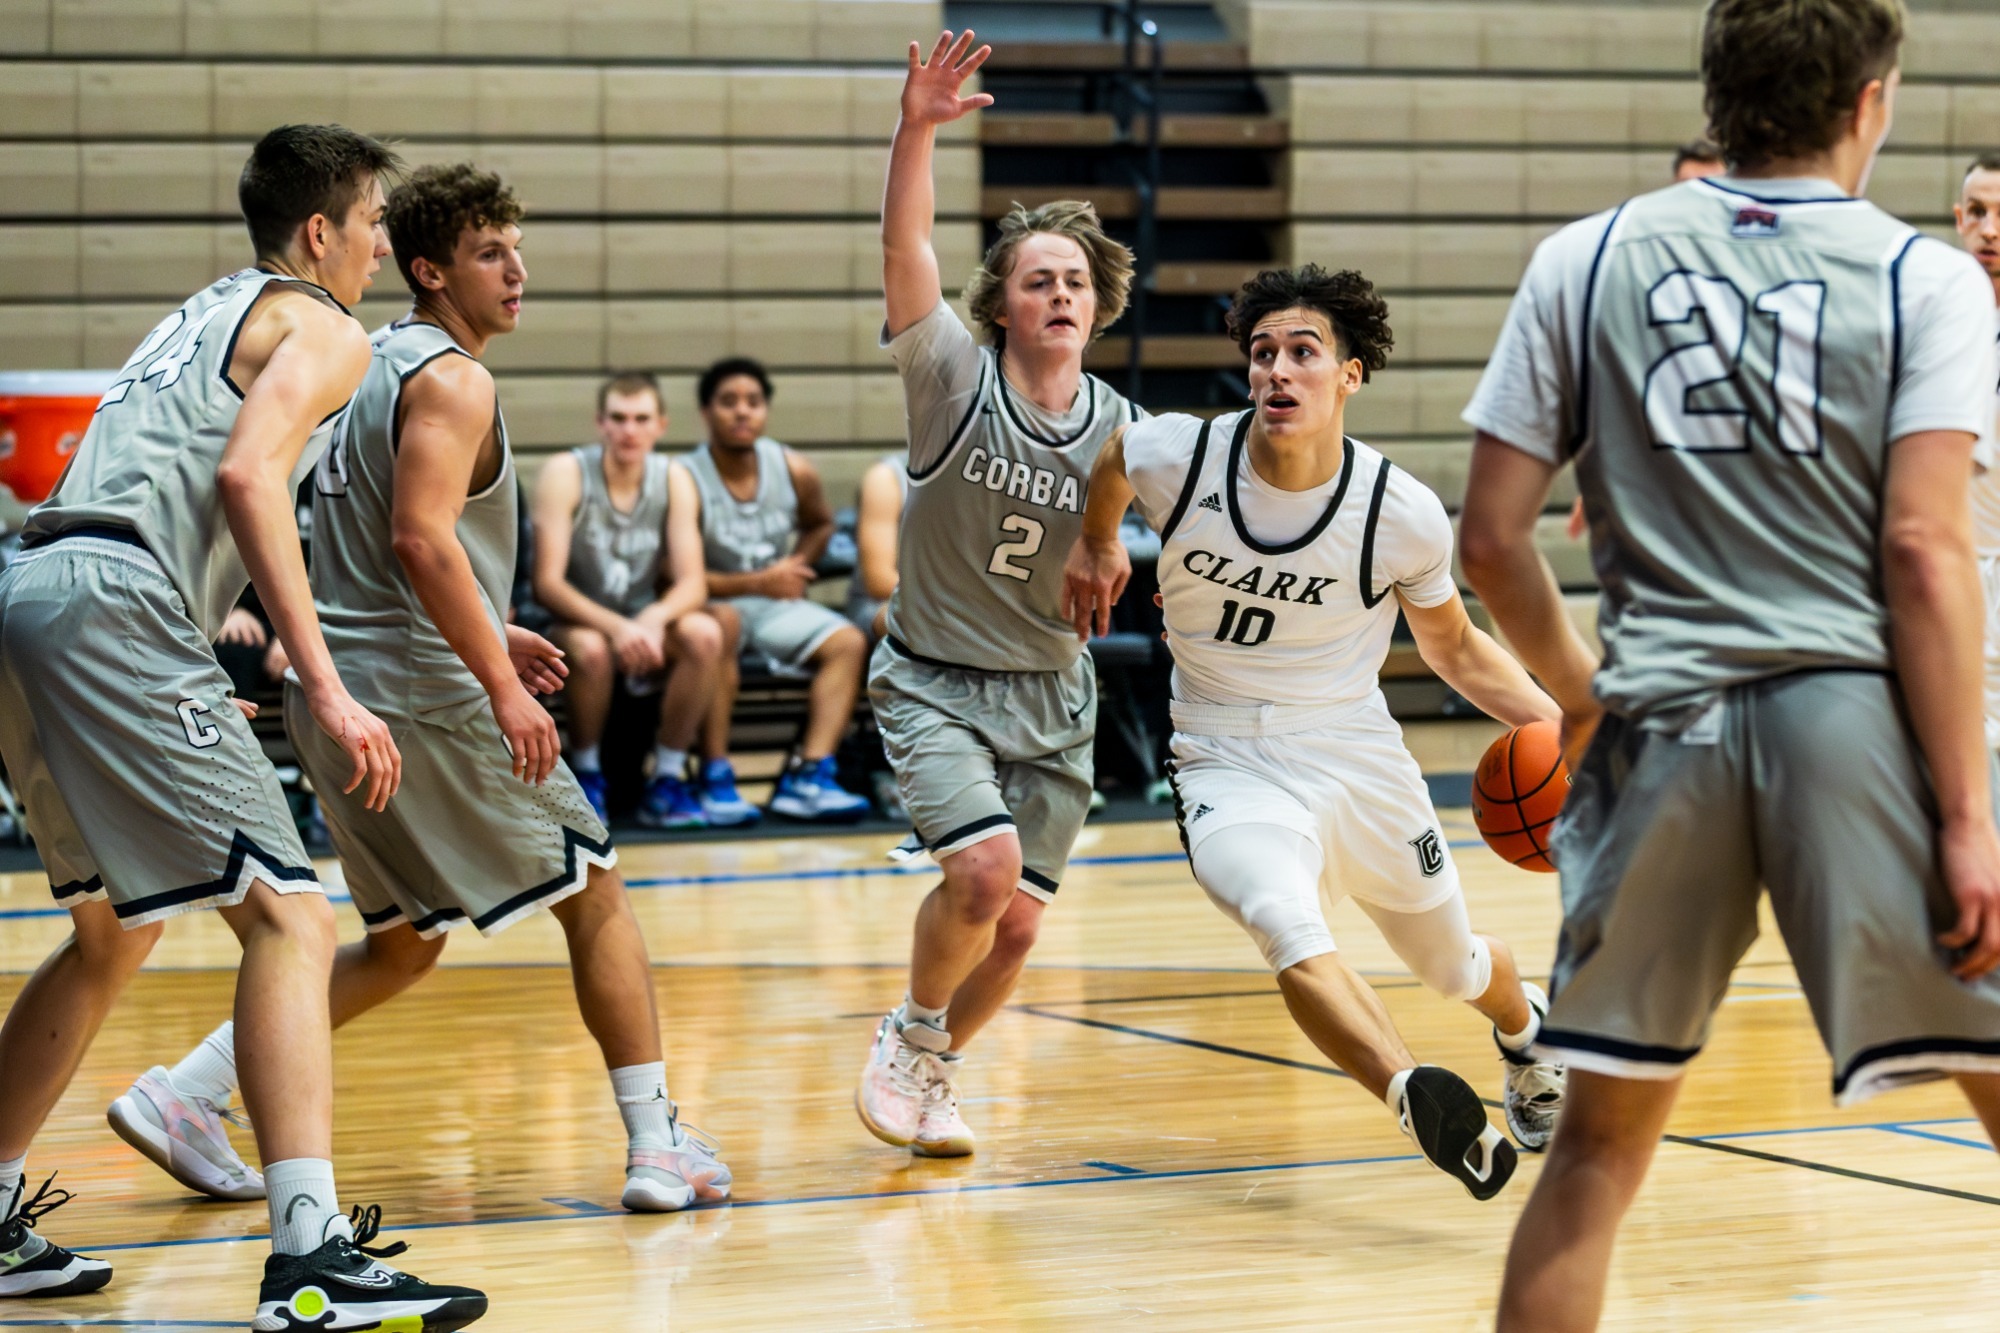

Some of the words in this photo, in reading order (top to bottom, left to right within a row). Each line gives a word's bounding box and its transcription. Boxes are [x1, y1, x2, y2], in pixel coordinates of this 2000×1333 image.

[1643, 269, 1827, 458] 21
[961, 446, 1090, 515] CORBA
[1198, 501, 1223, 513] adidas
[986, 512, 1047, 583] 2
[1183, 549, 1338, 606] CLARK
[1214, 600, 1276, 647] 10
[175, 698, 222, 749] C
